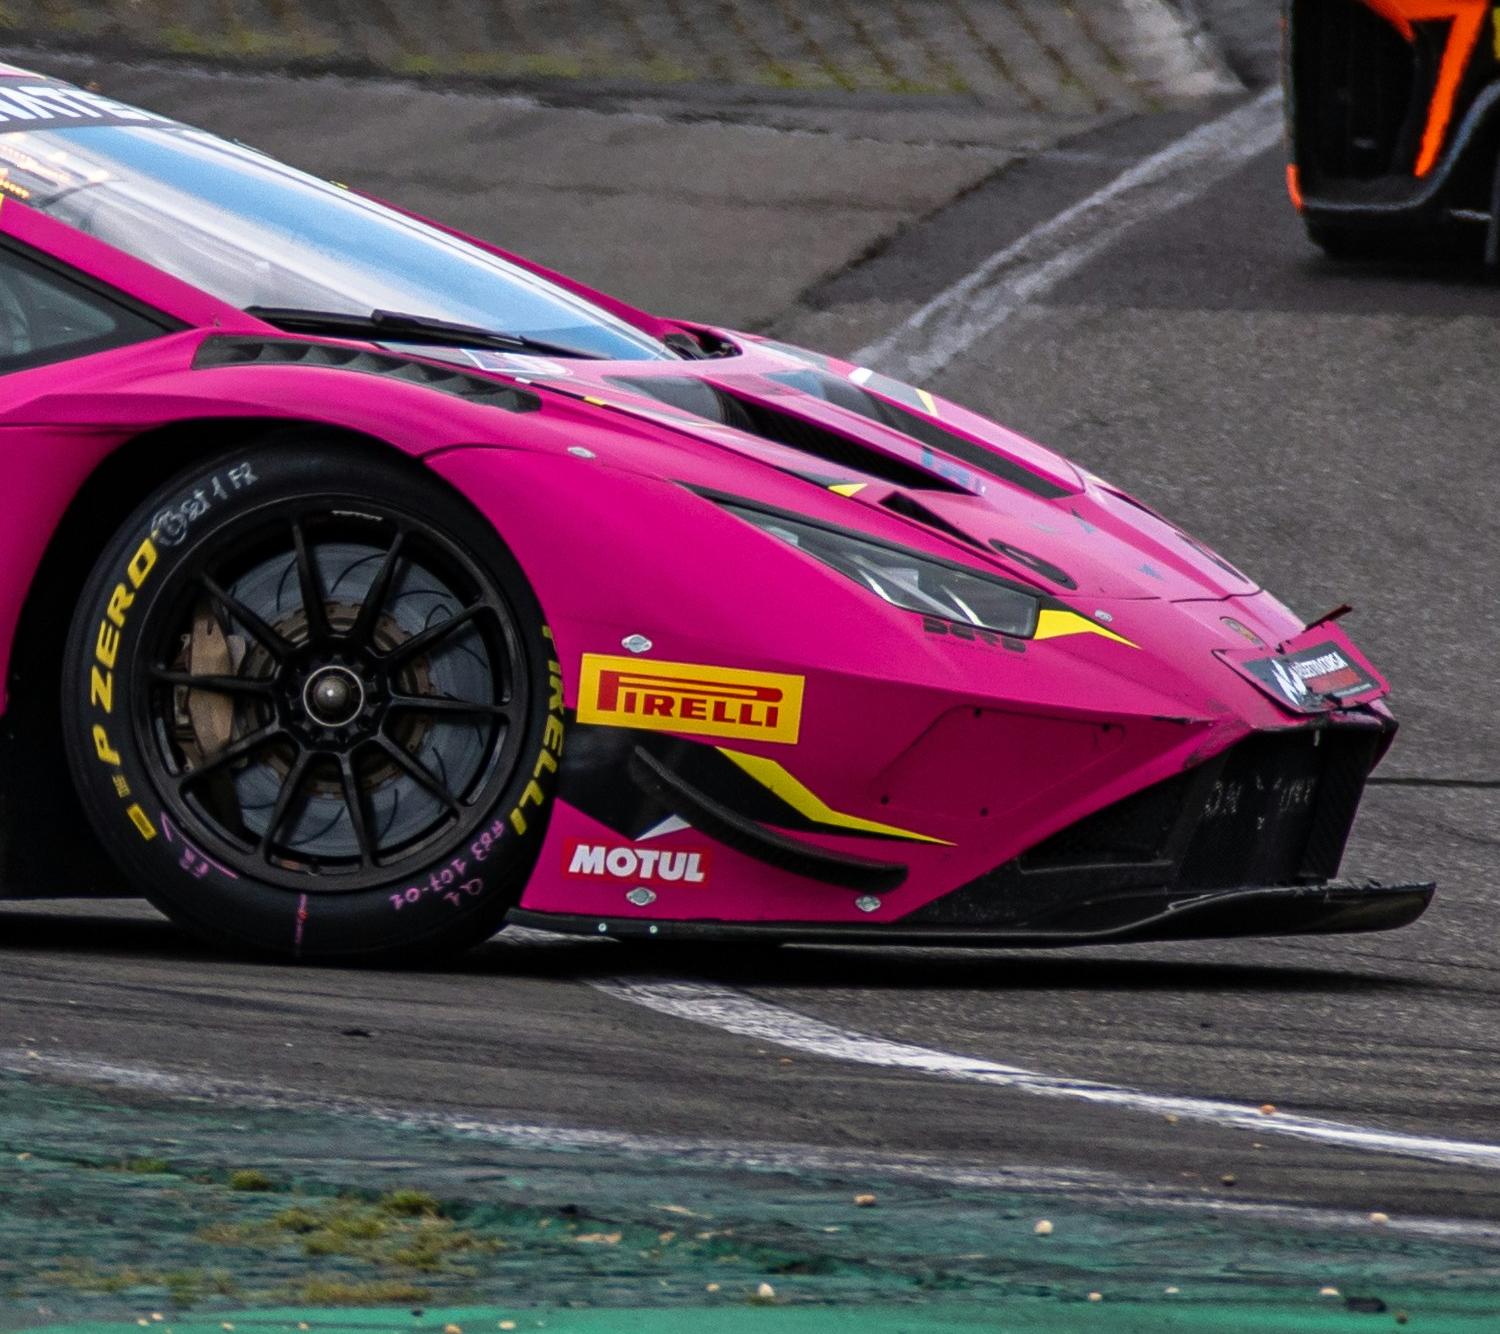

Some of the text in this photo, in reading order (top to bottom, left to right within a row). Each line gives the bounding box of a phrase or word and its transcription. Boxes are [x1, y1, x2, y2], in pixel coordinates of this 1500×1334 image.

[91, 538, 158, 766] P ZERO
[597, 670, 783, 728] PIRELLI
[568, 844, 705, 882] MOTUL
